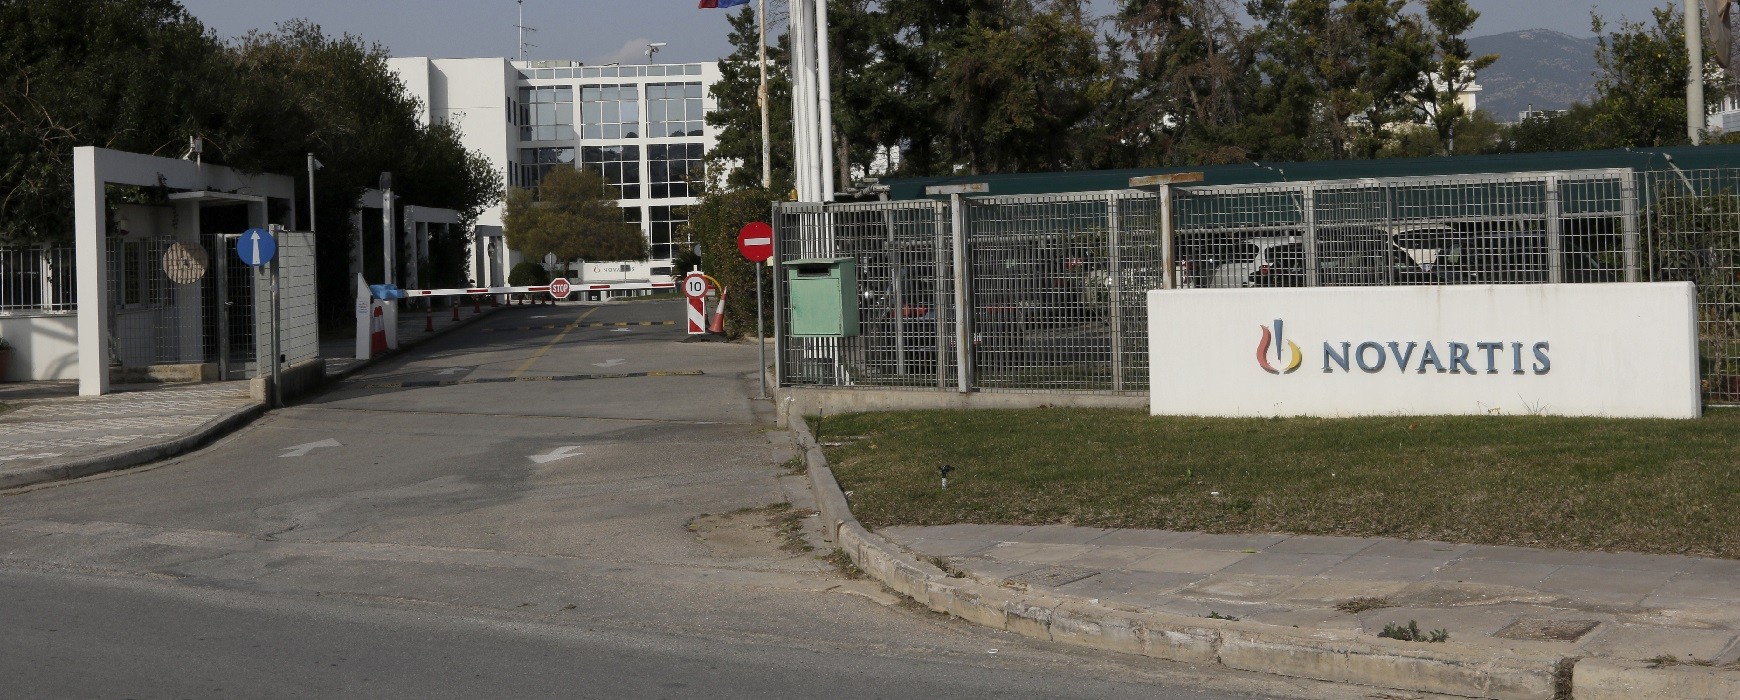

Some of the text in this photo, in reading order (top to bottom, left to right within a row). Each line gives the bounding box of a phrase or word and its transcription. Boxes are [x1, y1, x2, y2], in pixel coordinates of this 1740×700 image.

[552, 284, 569, 293] STOP
[689, 281, 702, 292] 10
[1321, 340, 1551, 375] NOVARTIS
